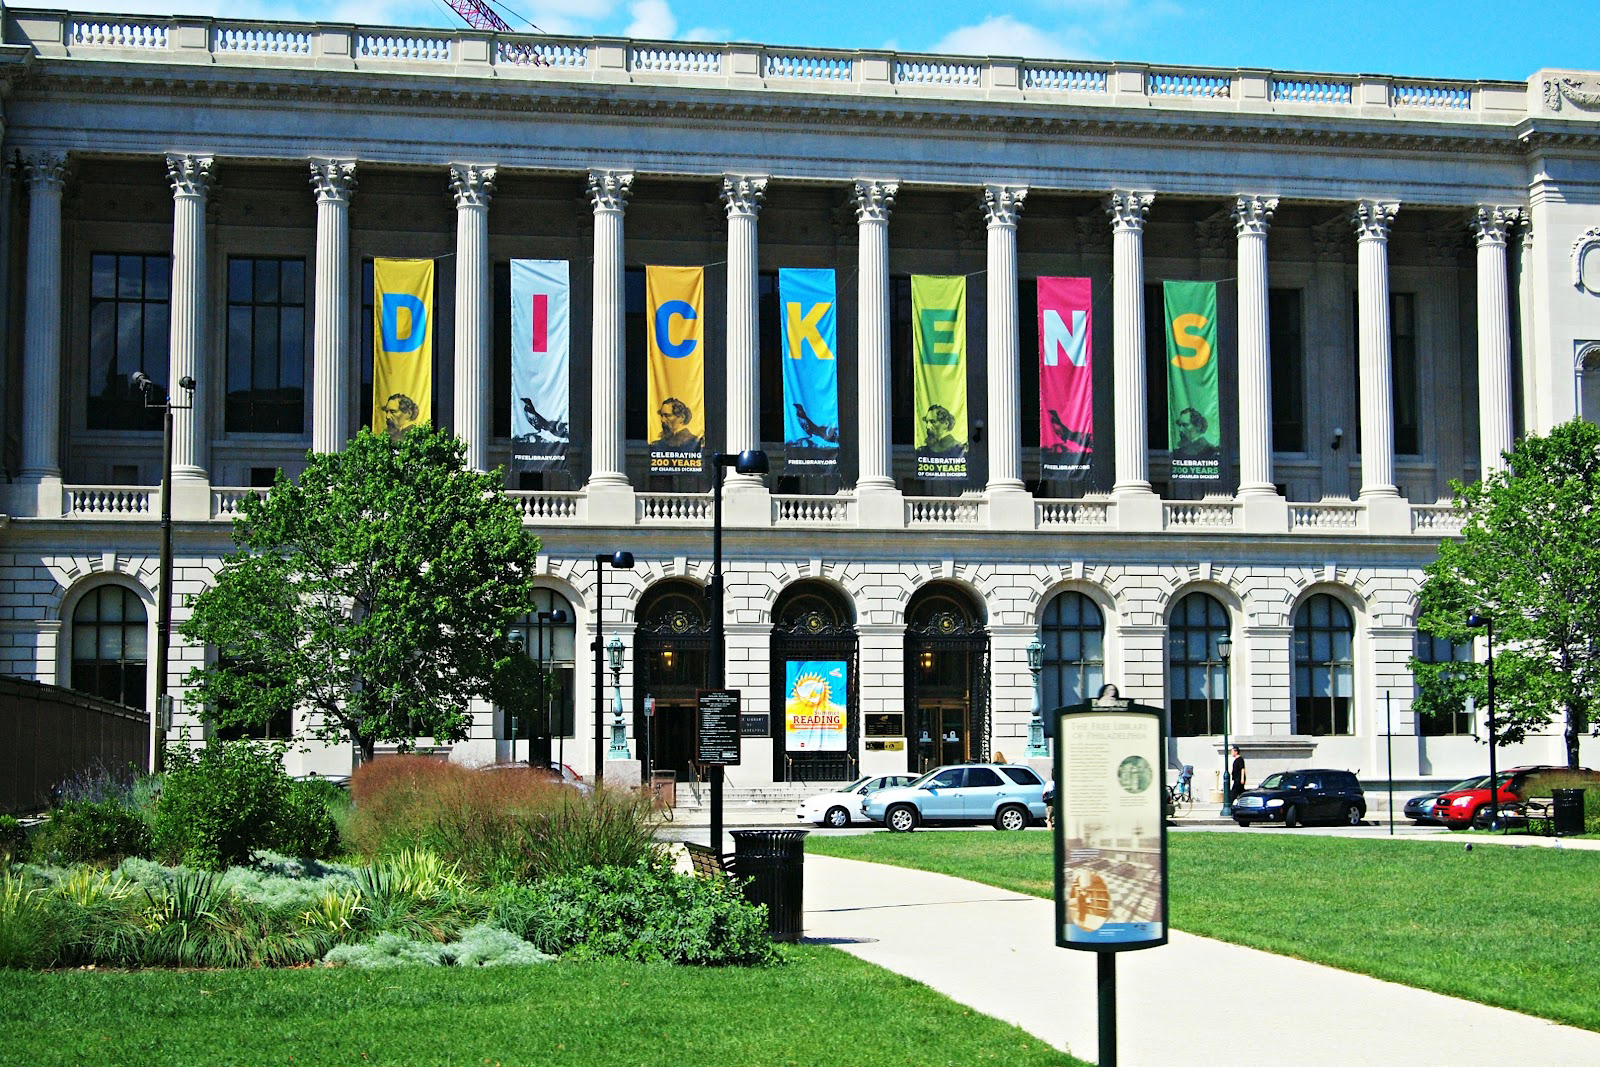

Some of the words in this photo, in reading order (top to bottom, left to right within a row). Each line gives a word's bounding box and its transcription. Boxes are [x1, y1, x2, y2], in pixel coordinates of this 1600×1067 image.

[382, 293, 426, 352] D
[532, 294, 548, 352] I
[654, 300, 698, 359] C
[786, 302, 834, 360] K
[919, 308, 960, 365] E
[1042, 310, 1087, 366] N
[1170, 313, 1211, 370] S
[650, 451, 702, 459] CELEBRATING
[651, 458, 670, 466] 200
[671, 459, 702, 467] YEARS
[917, 456, 966, 464] CELEBRATING
[936, 464, 966, 472] YEARS
[1171, 459, 1219, 467] CELEBRATING
[1171, 466, 1189, 474] 200
[1189, 466, 1219, 475] YEARS
[793, 715, 841, 724] READING
